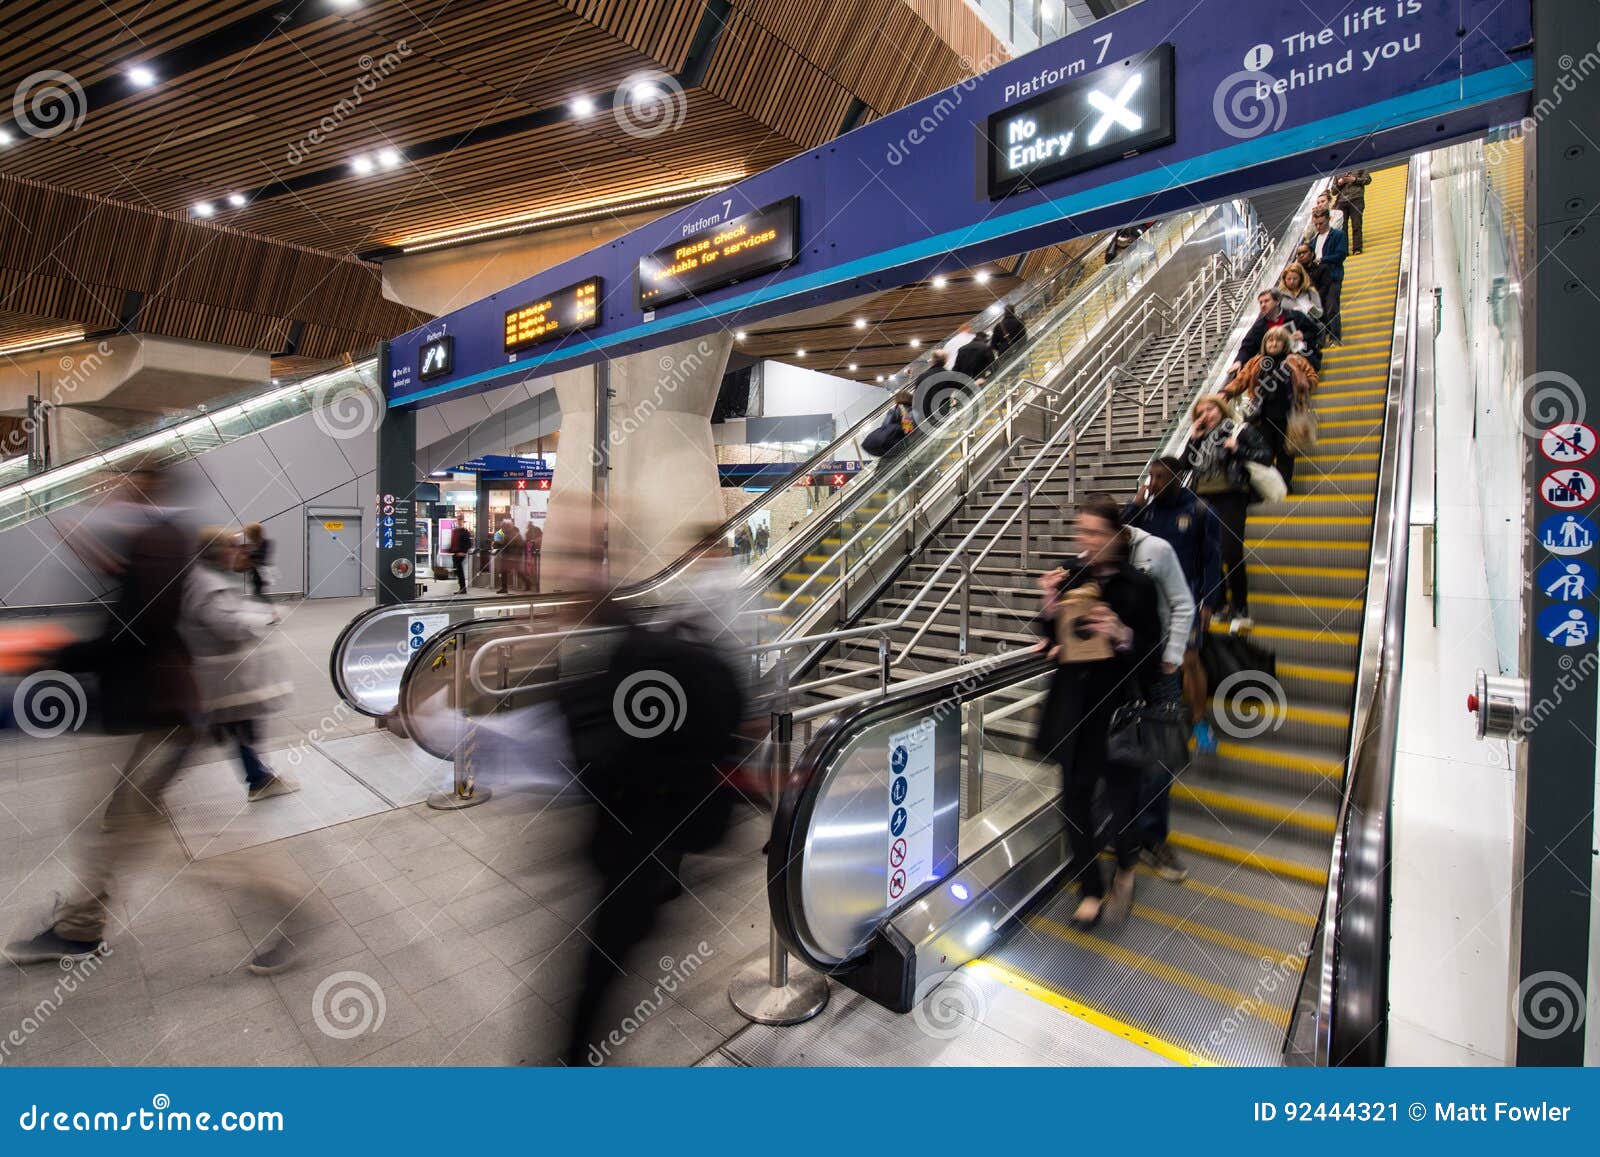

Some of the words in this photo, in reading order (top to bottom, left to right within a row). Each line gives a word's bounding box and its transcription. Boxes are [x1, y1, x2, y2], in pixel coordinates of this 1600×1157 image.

[1281, 28, 1334, 57] The
[1343, 6, 1386, 37] lift
[1397, 0, 1423, 18] is
[1004, 58, 1086, 102] Platform
[1092, 32, 1113, 65] 7
[1255, 50, 1353, 101] behind
[1362, 33, 1421, 72] you
[1009, 118, 1037, 144] No
[1009, 131, 1074, 170] Entry
[682, 213, 720, 237] Platform
[722, 199, 733, 220] 7
[676, 240, 710, 260] Please
[714, 225, 747, 246] check
[702, 250, 720, 265] for
[723, 229, 776, 256] services
[442, 323, 447, 336] 7
